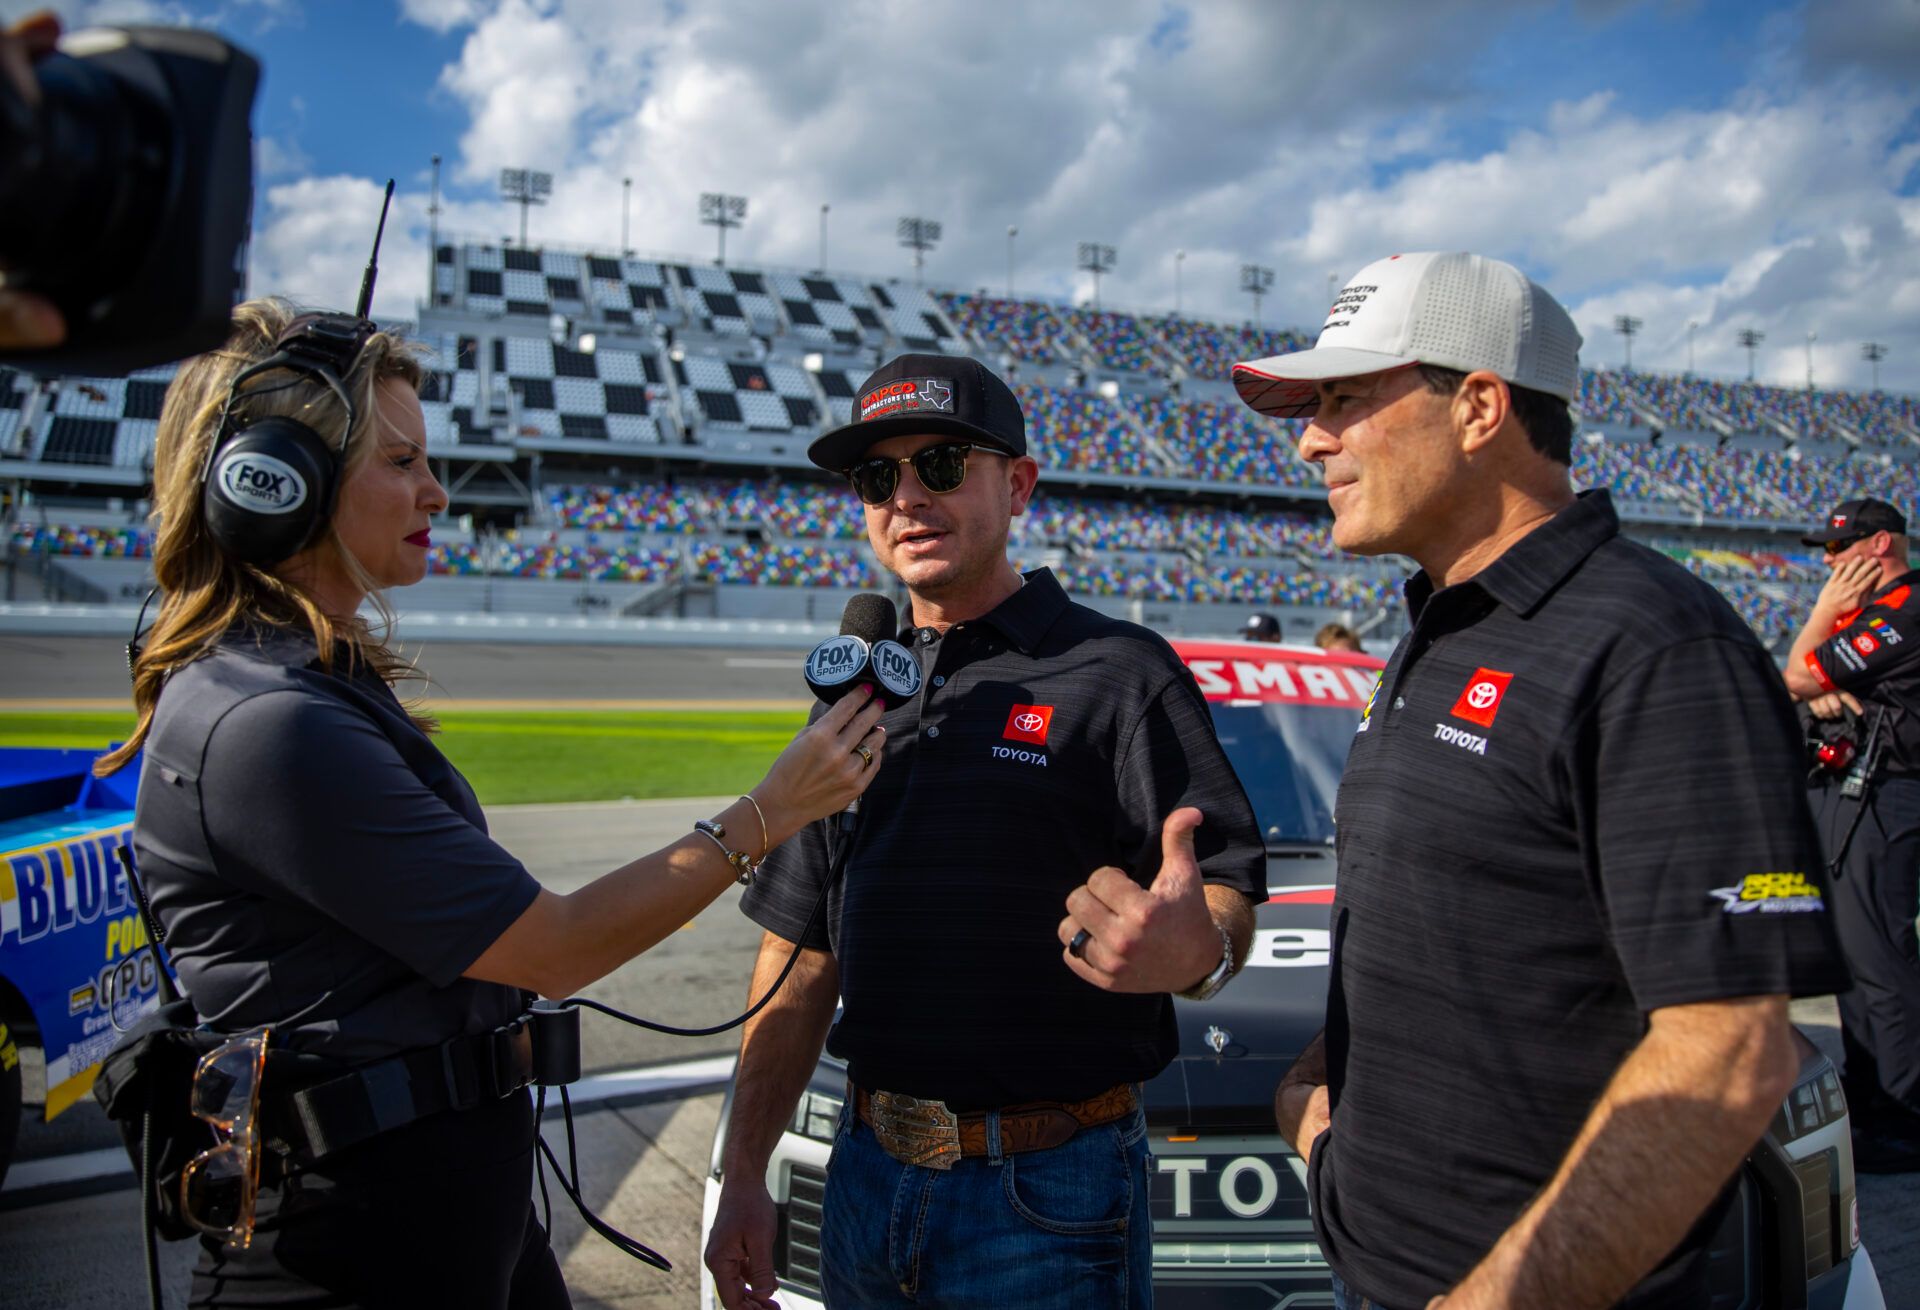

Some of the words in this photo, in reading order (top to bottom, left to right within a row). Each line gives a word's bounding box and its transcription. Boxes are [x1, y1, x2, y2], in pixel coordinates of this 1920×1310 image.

[862, 382, 917, 409] CAPCO
[862, 395, 900, 416] CONTRACTORS
[238, 464, 286, 495] FOX
[235, 483, 283, 504] SPORTS
[817, 643, 856, 669] FOX
[882, 647, 912, 680] FOX
[815, 663, 854, 677] SPORTS
[881, 668, 911, 689] SPORTS
[1433, 723, 1488, 756] TOYOTA
[991, 745, 1047, 767] TOYOTA
[106, 911, 160, 960] POO
